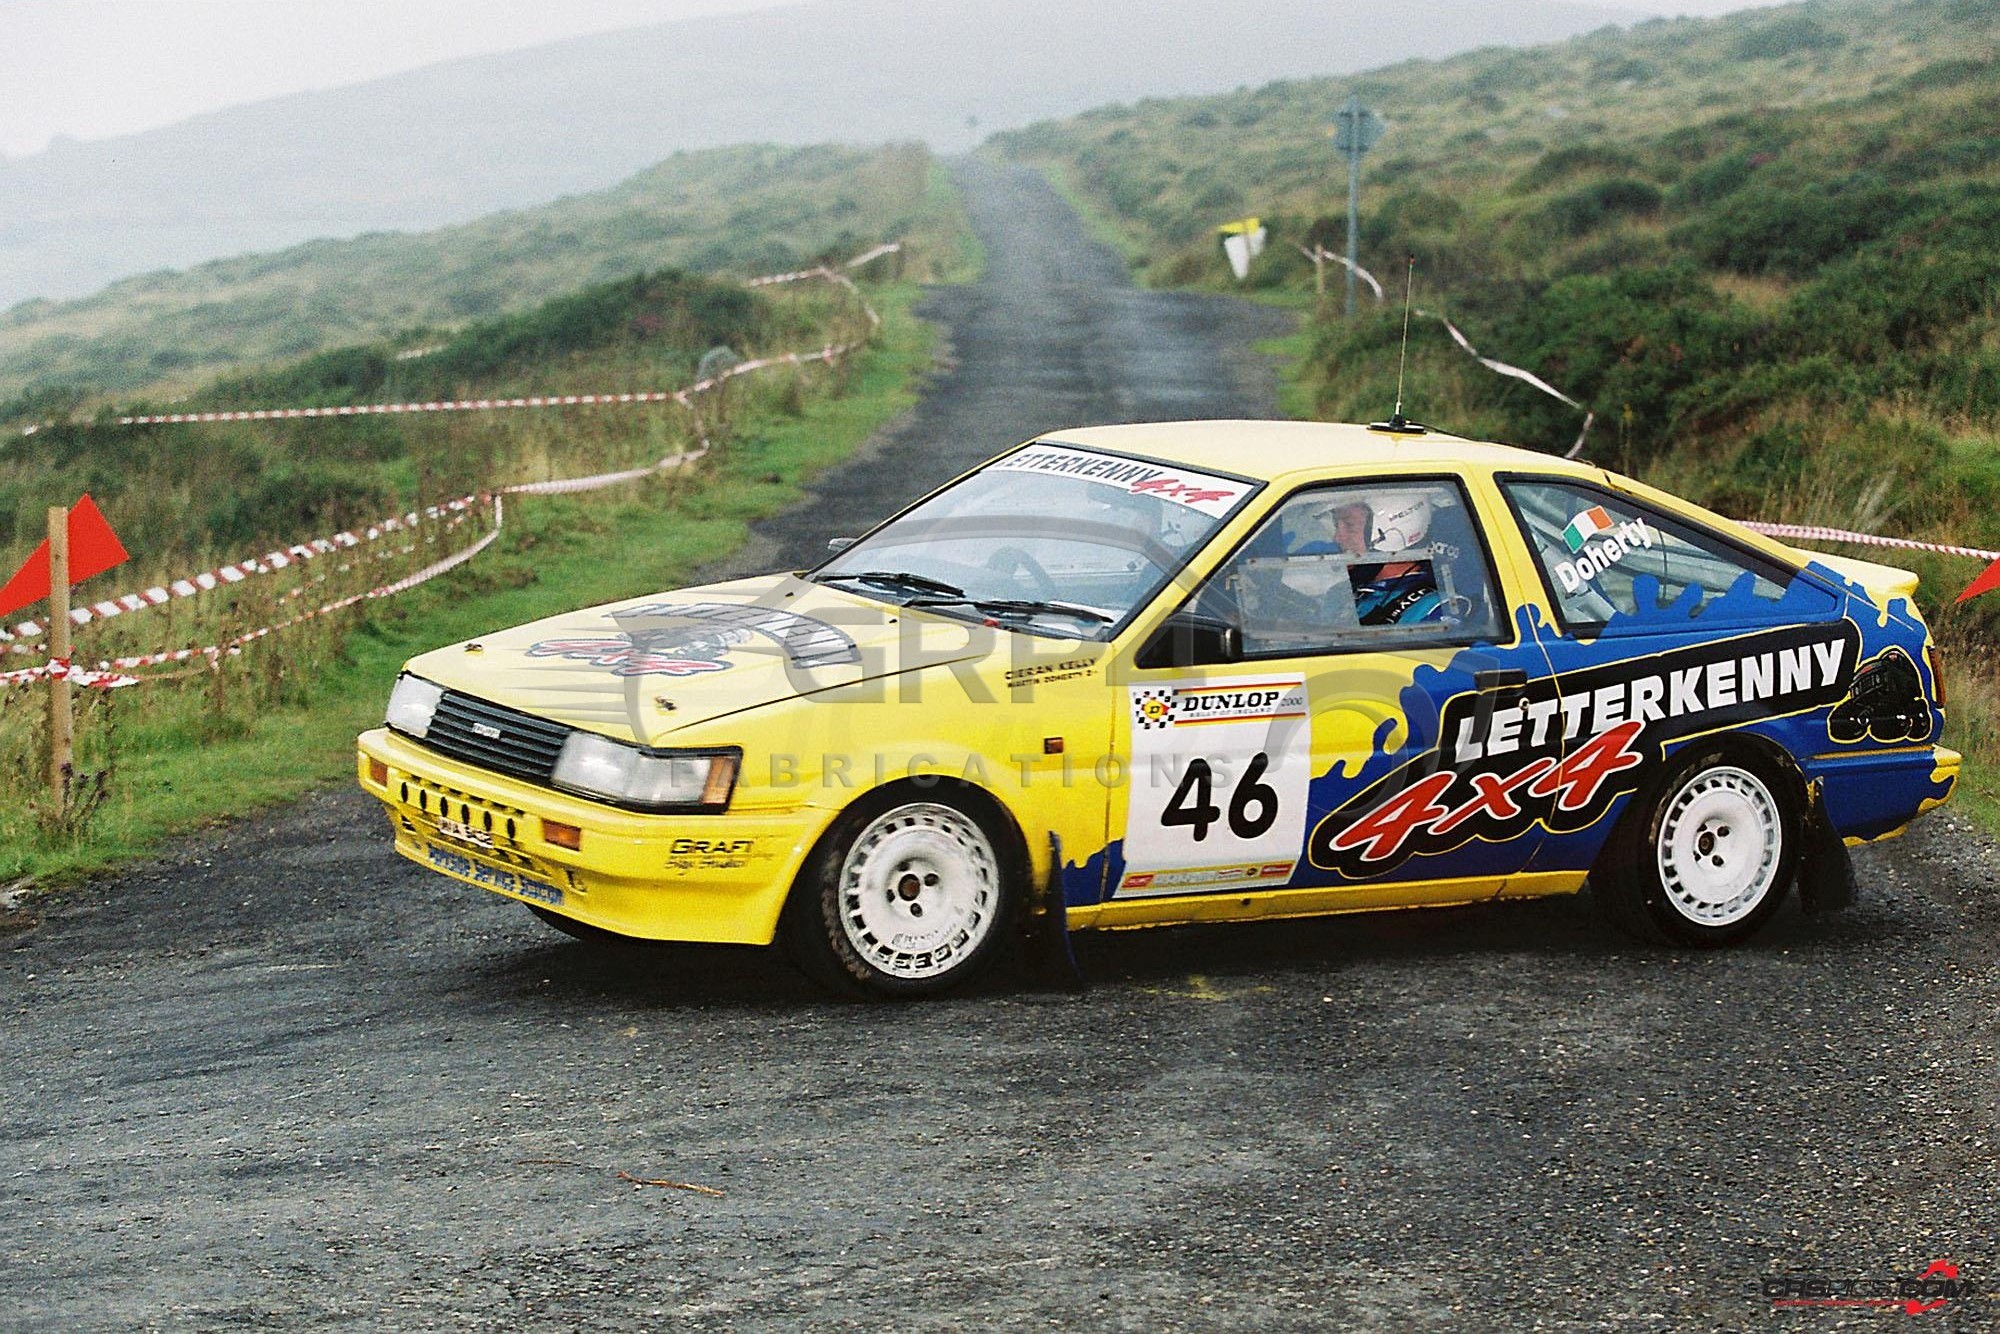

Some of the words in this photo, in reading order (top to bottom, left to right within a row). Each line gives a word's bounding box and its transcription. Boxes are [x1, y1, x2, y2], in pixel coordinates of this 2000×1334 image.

[1554, 518, 1652, 592] Doherty
[1059, 658, 1096, 670] KELLY
[1182, 691, 1279, 711] DUNLOP
[1456, 638, 1845, 763] LETTERKENNY
[1161, 751, 1279, 842] 46
